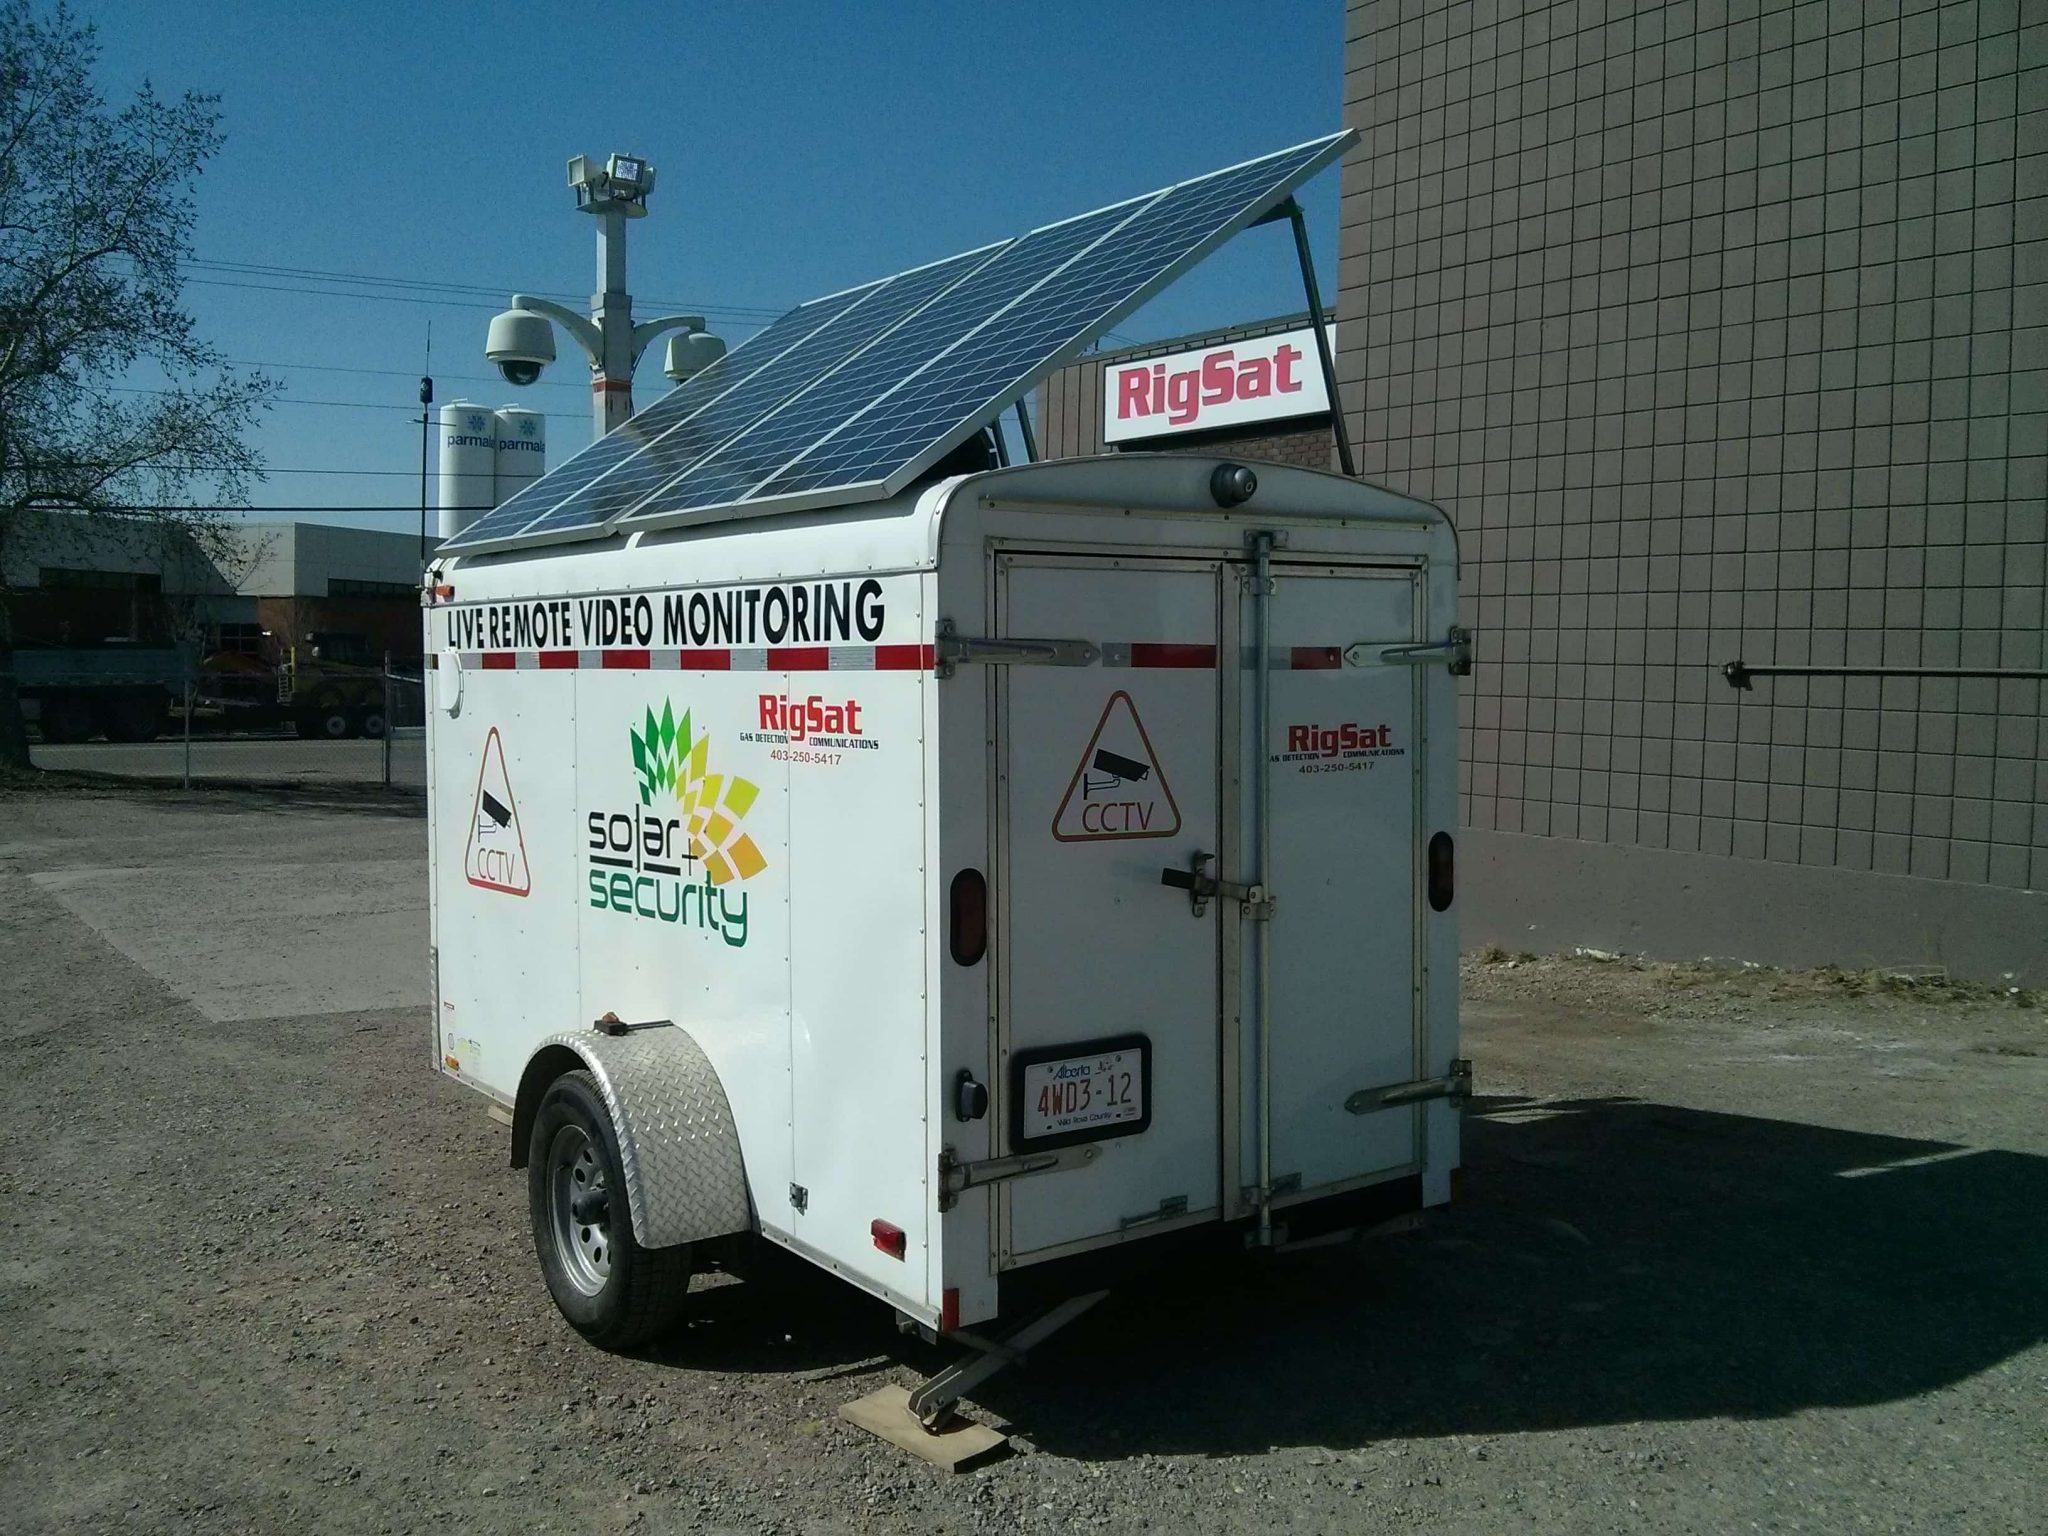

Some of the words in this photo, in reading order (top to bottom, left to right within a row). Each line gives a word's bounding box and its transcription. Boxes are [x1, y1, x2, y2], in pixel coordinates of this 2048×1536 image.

[1117, 344, 1302, 425] RigSat
[448, 608, 485, 650] LIVE
[489, 601, 571, 648] REMOTE
[579, 595, 653, 646] VIDEO
[663, 579, 885, 646] MONITORING
[759, 694, 863, 741] RigSat
[739, 732, 753, 742] GAS
[755, 733, 789, 744] DETECTION
[809, 736, 879, 750] COMMUNICATIONS
[1282, 752, 1320, 762] DETECTION
[1343, 748, 1405, 758] COMMUNICATIONS
[1288, 723, 1392, 757] RigSat
[770, 749, 842, 765] 403-250-5417
[1299, 761, 1375, 773] 403-250-5417
[1082, 802, 1154, 833] CCTV
[477, 847, 516, 885] CCTV
[589, 870, 748, 948] security
[1053, 1064, 1091, 1080] Alberta
[1089, 1111, 1113, 1122] County
